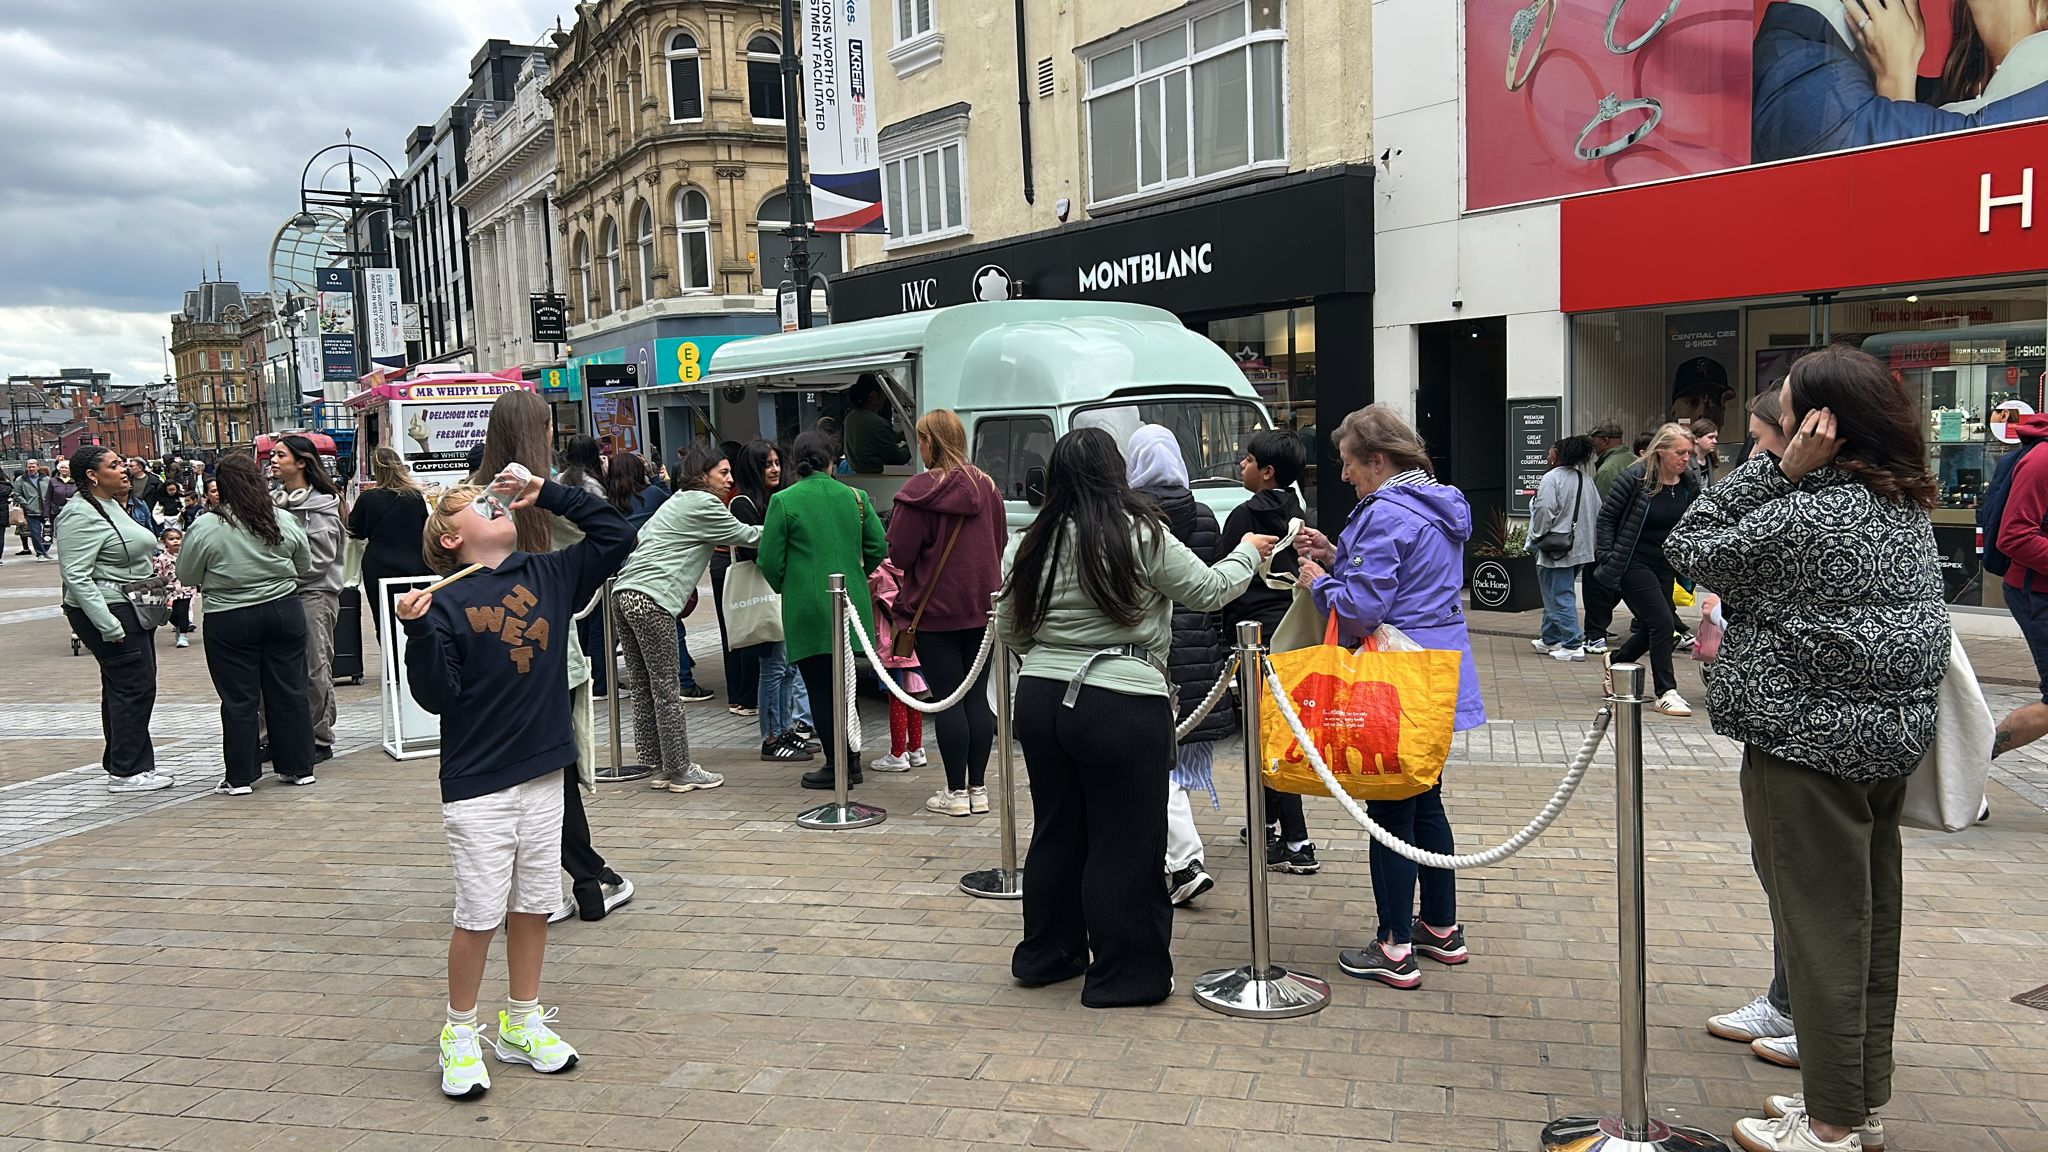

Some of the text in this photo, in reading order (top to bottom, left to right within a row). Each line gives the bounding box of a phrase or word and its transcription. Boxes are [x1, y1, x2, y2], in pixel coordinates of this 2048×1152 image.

[822, 0, 835, 106] IONS WORTH OF
[813, 54, 825, 131] FACILITATED
[1078, 242, 1212, 293] MONTBLANC
[901, 278, 938, 312] IWC
[1672, 332, 1714, 341] CENTRAL
[1685, 339, 1718, 348] G-SHOCK
[1904, 349, 1938, 361] HUGO
[2014, 345, 2046, 357] G-SHOC
[416, 387, 434, 397] MR
[437, 386, 479, 396] WHIPPY
[429, 410, 466, 420] DELICIOUS
[466, 410, 479, 419] ICE
[436, 429, 486, 439] FRESHLY GRO
[440, 451, 470, 459] WHITBY
[415, 462, 470, 470] CAPPUCCINO
[1475, 579, 1509, 589] Pack Horse
[730, 594, 777, 610] MORPHE
